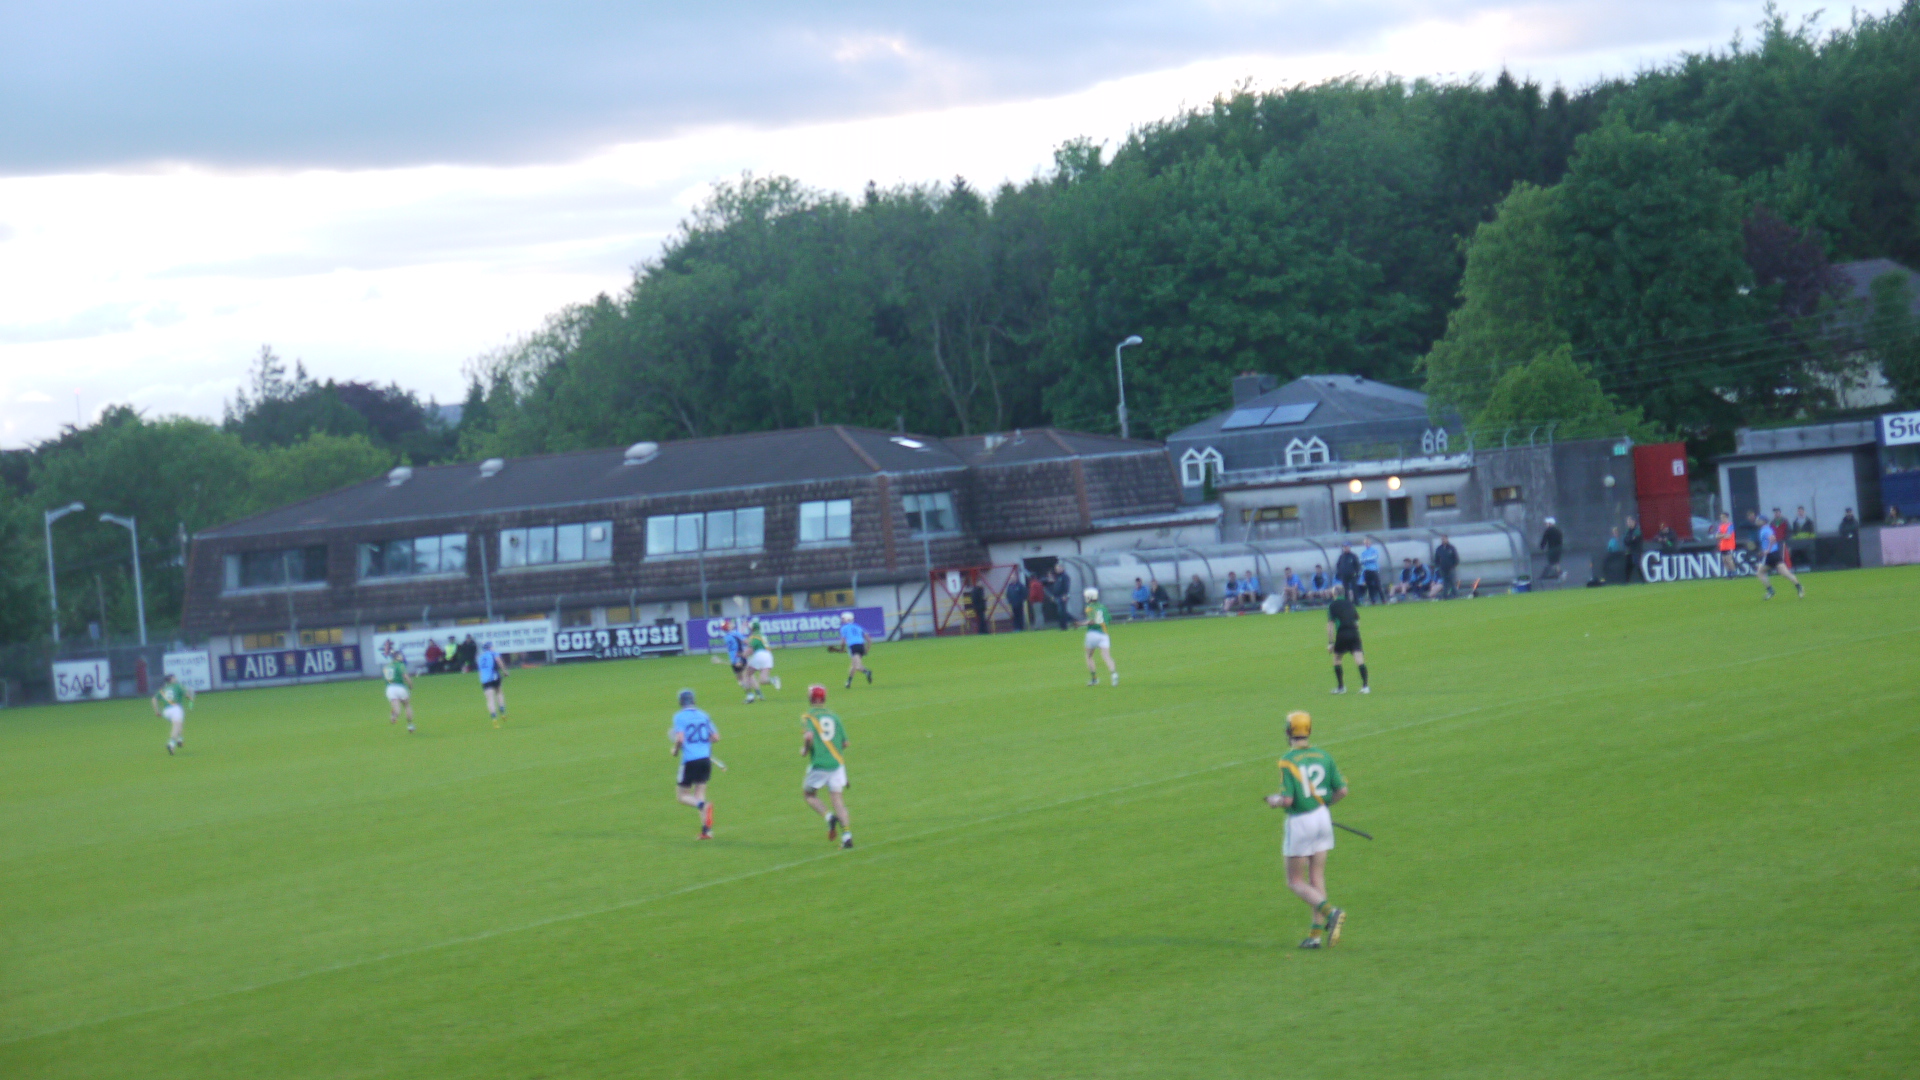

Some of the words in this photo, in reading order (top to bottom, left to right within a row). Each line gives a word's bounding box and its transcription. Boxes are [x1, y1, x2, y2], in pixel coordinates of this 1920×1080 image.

[616, 625, 679, 647] RUSH
[244, 655, 278, 679] AIB
[303, 650, 336, 674] AIB
[685, 723, 709, 743] 20
[820, 716, 835, 741] 9
[1299, 763, 1327, 798] 12
